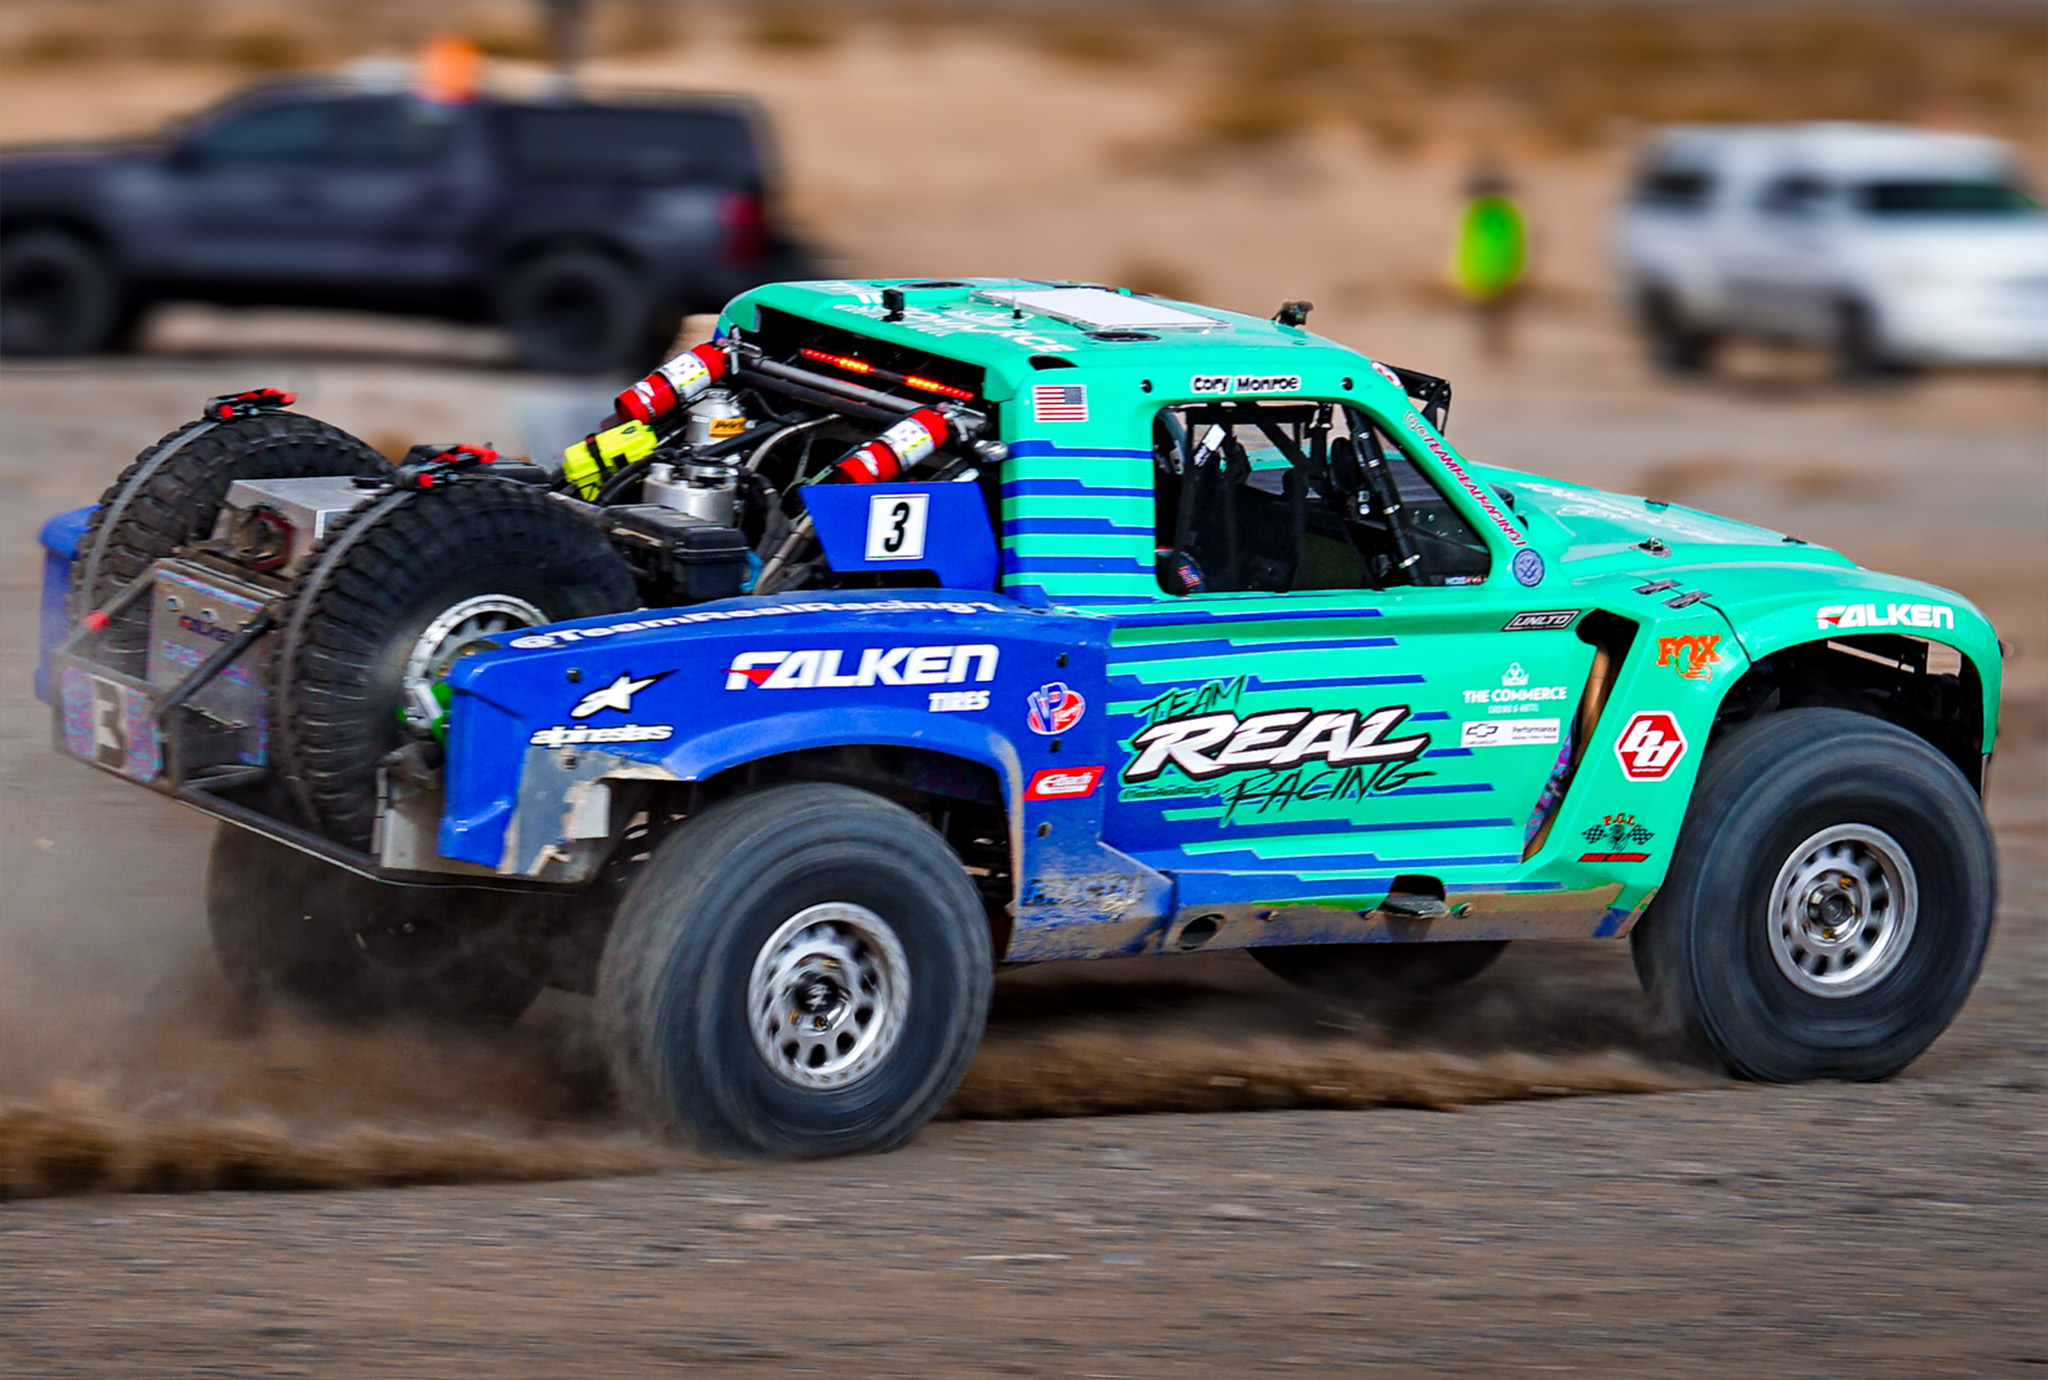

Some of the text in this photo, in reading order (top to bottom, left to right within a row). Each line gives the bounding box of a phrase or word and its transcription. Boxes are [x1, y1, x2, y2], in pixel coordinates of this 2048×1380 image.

[1193, 376, 1299, 393] Cory Monroe
[884, 501, 911, 553] 3
[1813, 602, 1956, 630] FALKEN
[723, 643, 1000, 691] FALKEN
[1656, 633, 1722, 673] FOX
[928, 690, 991, 713] TIRES
[1138, 676, 1246, 722] TEAM
[1462, 686, 1568, 703] THE COMMERCE
[1122, 704, 1432, 784] REAL
[1222, 761, 1437, 826] RACING
